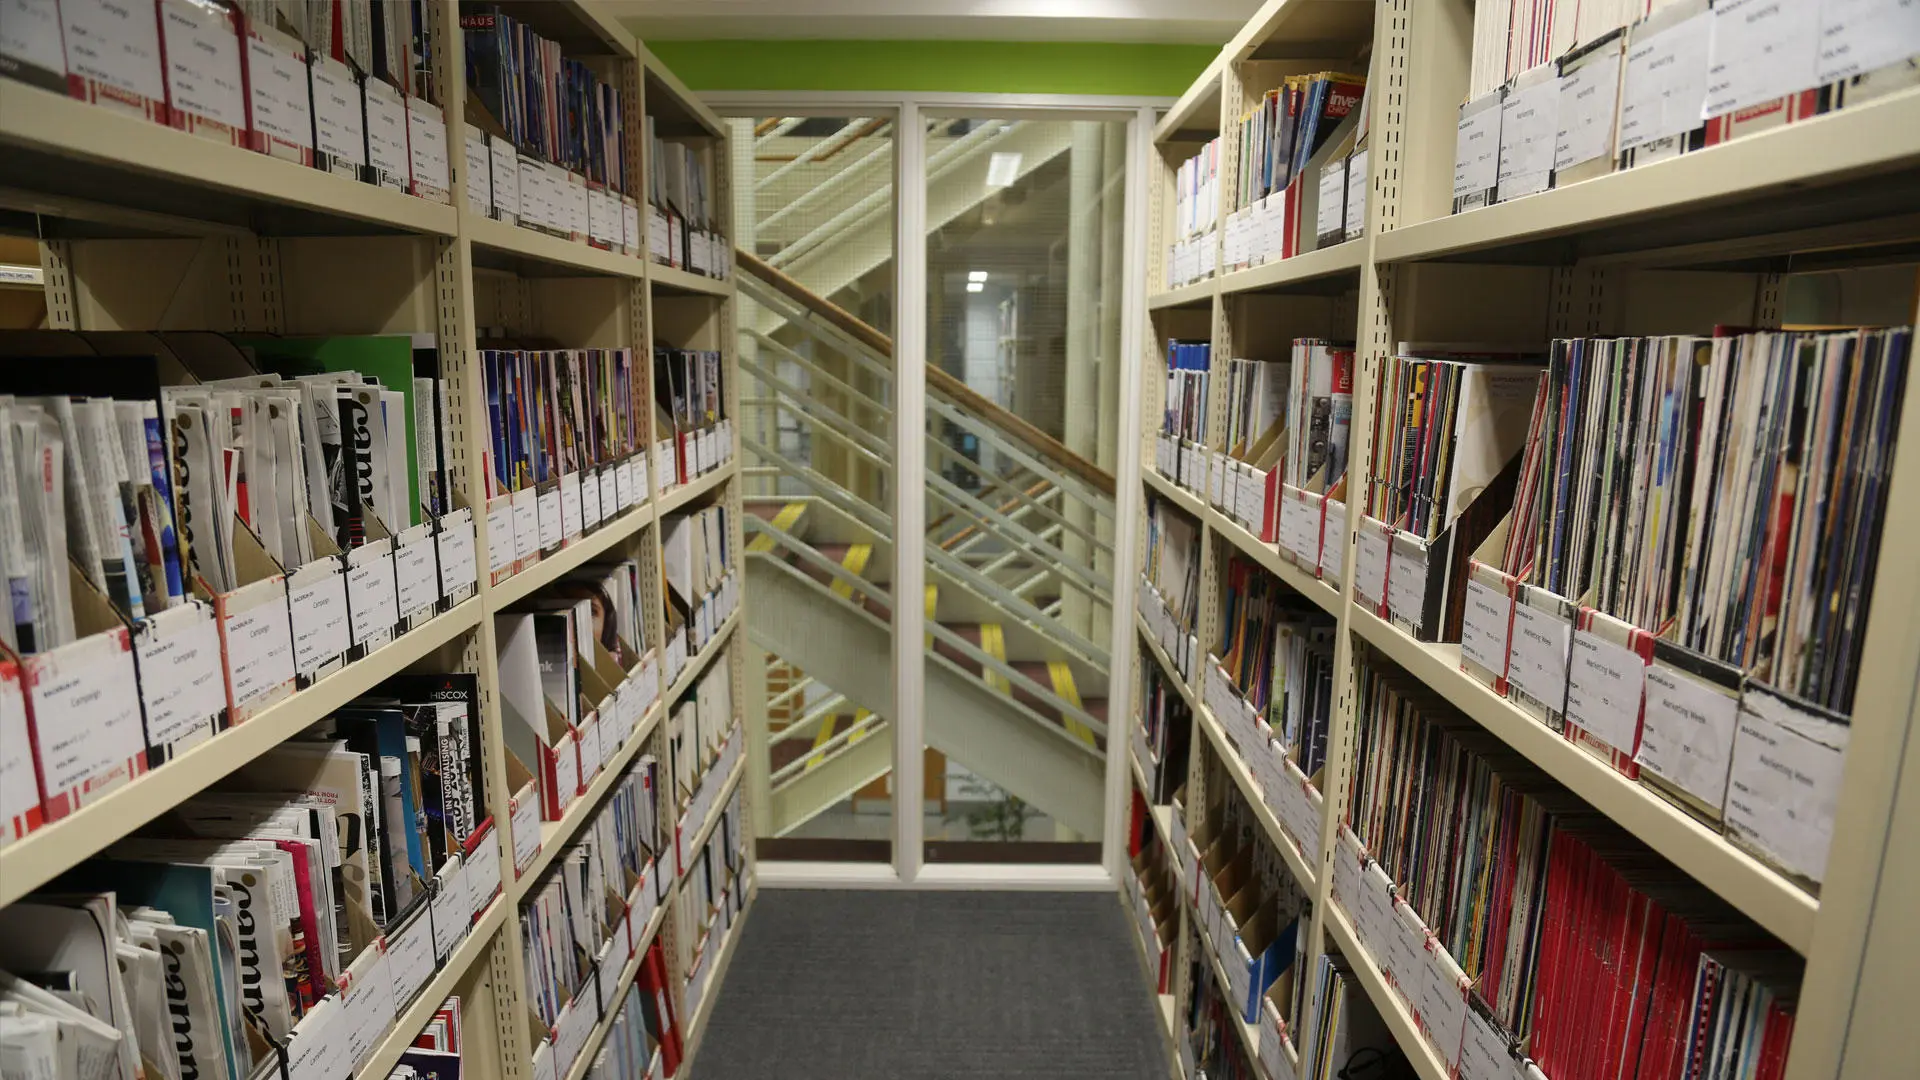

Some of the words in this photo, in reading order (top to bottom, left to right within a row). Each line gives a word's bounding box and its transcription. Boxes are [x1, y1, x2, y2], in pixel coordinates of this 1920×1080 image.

[461, 17, 496, 26] HAUS
[350, 400, 374, 507] cam
[430, 690, 470, 701] HISCOX
